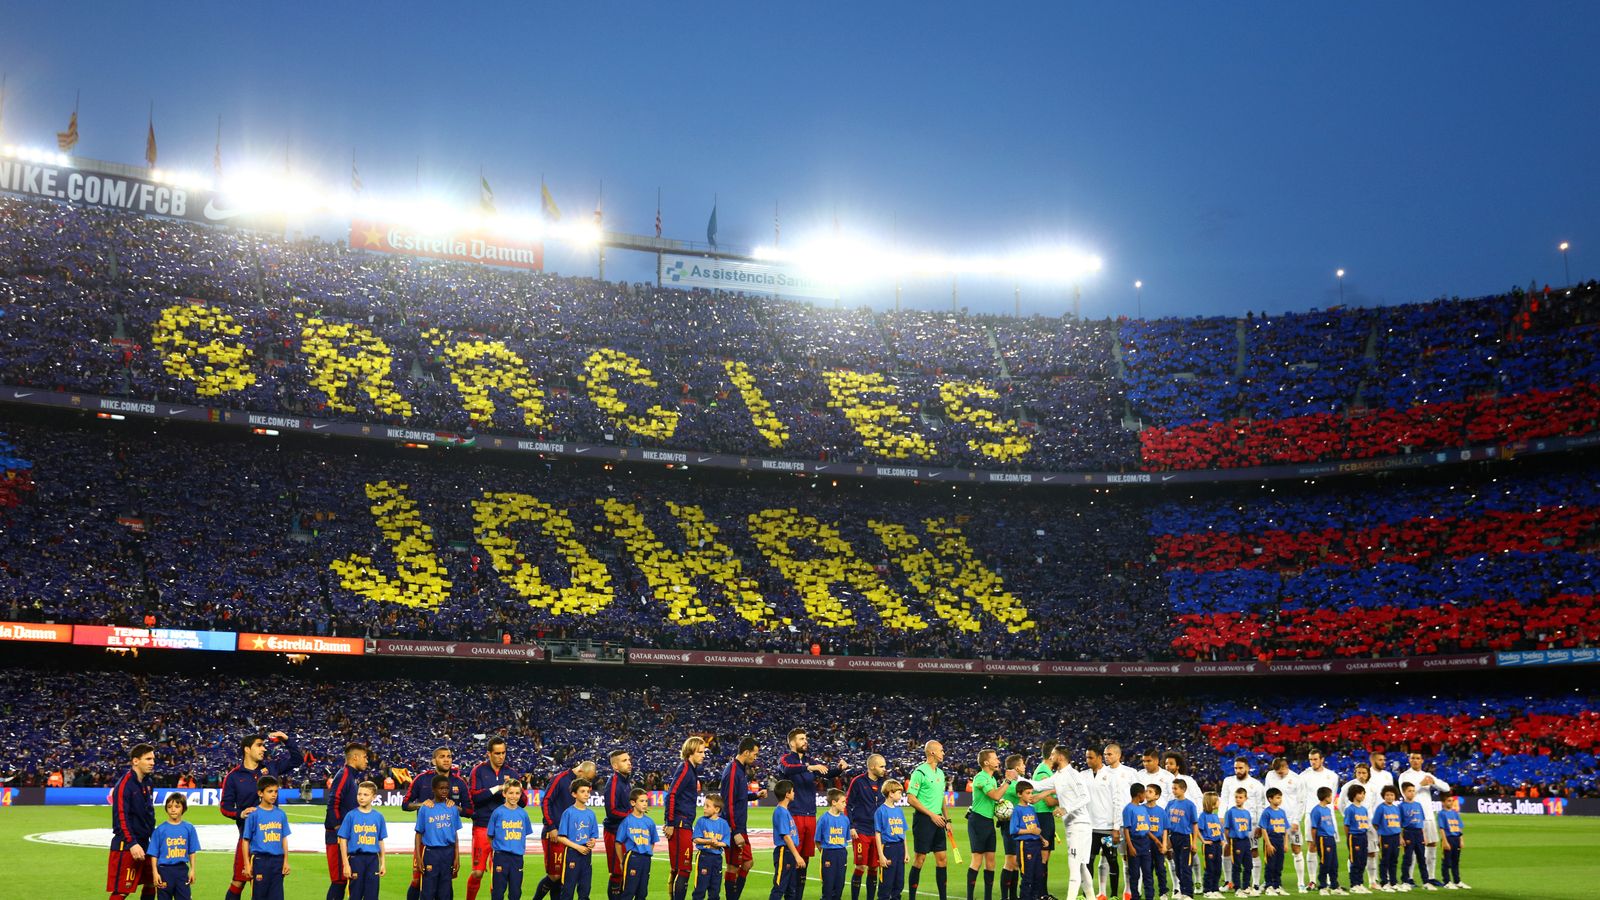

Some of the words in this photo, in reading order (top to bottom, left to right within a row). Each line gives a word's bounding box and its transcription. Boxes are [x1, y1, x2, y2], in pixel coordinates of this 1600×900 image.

[387, 229, 467, 256] Estrella
[470, 240, 534, 264] Damm
[690, 265, 774, 285] Assistència
[100, 400, 155, 414] NIKE.COM/FCB
[250, 414, 300, 428] NIKE.COM/FCB
[387, 429, 435, 441] NIKE.COM/FCB
[518, 441, 564, 452] NIKE.COM/FCB
[642, 451, 686, 462] NIKE.COM/FCB
[762, 460, 804, 470] NIKE.COM/FCB
[877, 468, 918, 477] NIKE.COM/FCB
[990, 474, 1032, 482] NIKE.COM/FCB
[1107, 474, 1150, 482] NIKE.COM/FCB
[12, 626, 56, 640] Damm
[267, 636, 312, 650] Estrella
[313, 639, 351, 652] Damm
[1572, 649, 1594, 658] beko
[384, 792, 403, 806] Joh
[527, 793, 540, 806] 14
[652, 795, 664, 806] 14
[1478, 798, 1512, 814] Gràcies
[1514, 799, 1544, 815] Johan
[1548, 801, 1563, 814] 14
[357, 834, 376, 845] Johan
[504, 830, 522, 840] Johan
[684, 848, 690, 858] 4
[857, 843, 862, 853] 8
[1071, 849, 1076, 858] 4
[554, 852, 562, 864] 14
[126, 868, 135, 881] 10
